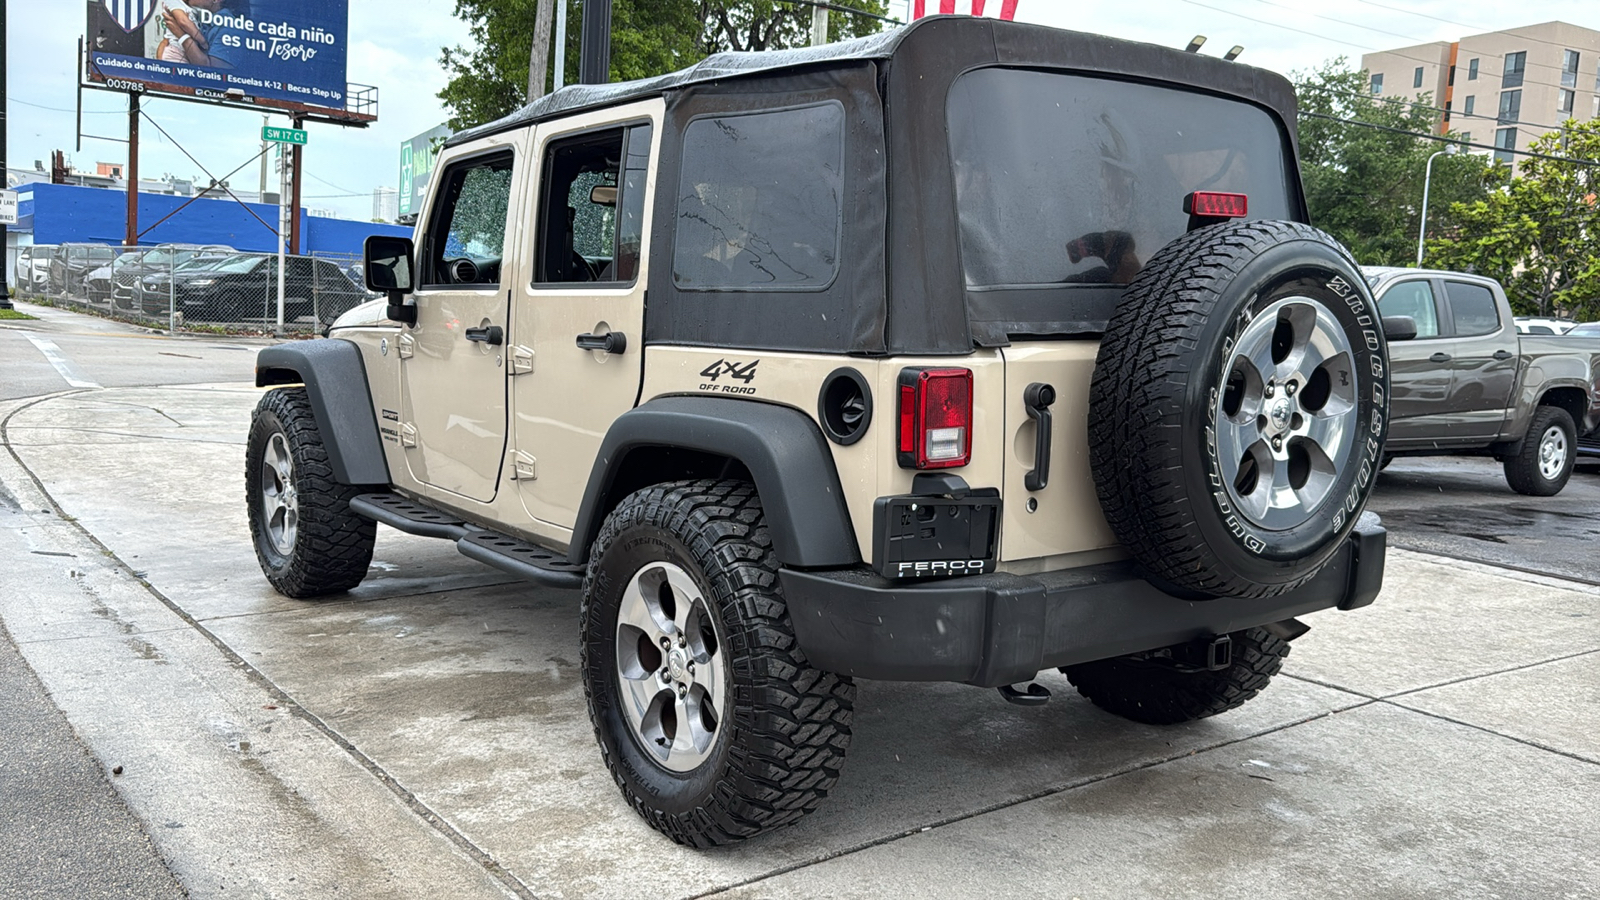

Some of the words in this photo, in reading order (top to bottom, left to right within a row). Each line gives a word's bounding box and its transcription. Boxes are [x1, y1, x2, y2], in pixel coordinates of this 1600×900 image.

[201, 9, 254, 31] Donde
[258, 21, 297, 39] cada
[301, 27, 335, 45] niño
[222, 34, 241, 47] es
[245, 37, 266, 52] un
[268, 37, 317, 61] Tesoro
[96, 57, 133, 69] Cuidado
[134, 61, 146, 71] de
[147, 64, 171, 74] niños
[176, 67, 195, 78] VPK
[196, 70, 222, 81] Gratis
[227, 74, 263, 87] Escuelas
[264, 80, 282, 90] K-12
[287, 83, 311, 94] Becas
[312, 87, 330, 99] Step
[331, 90, 342, 100] Up
[107, 78, 144, 92] 003785
[267, 129, 280, 139] SW
[282, 131, 292, 140] 17
[294, 132, 304, 142] Ct
[699, 383, 720, 391] OFF
[721, 385, 757, 395] ROAD
[1326, 275, 1384, 534] BRIDGESTONE
[1205, 386, 1267, 555] DUELER
[898, 560, 985, 571] FERCO
[898, 568, 984, 577] MOTORS
